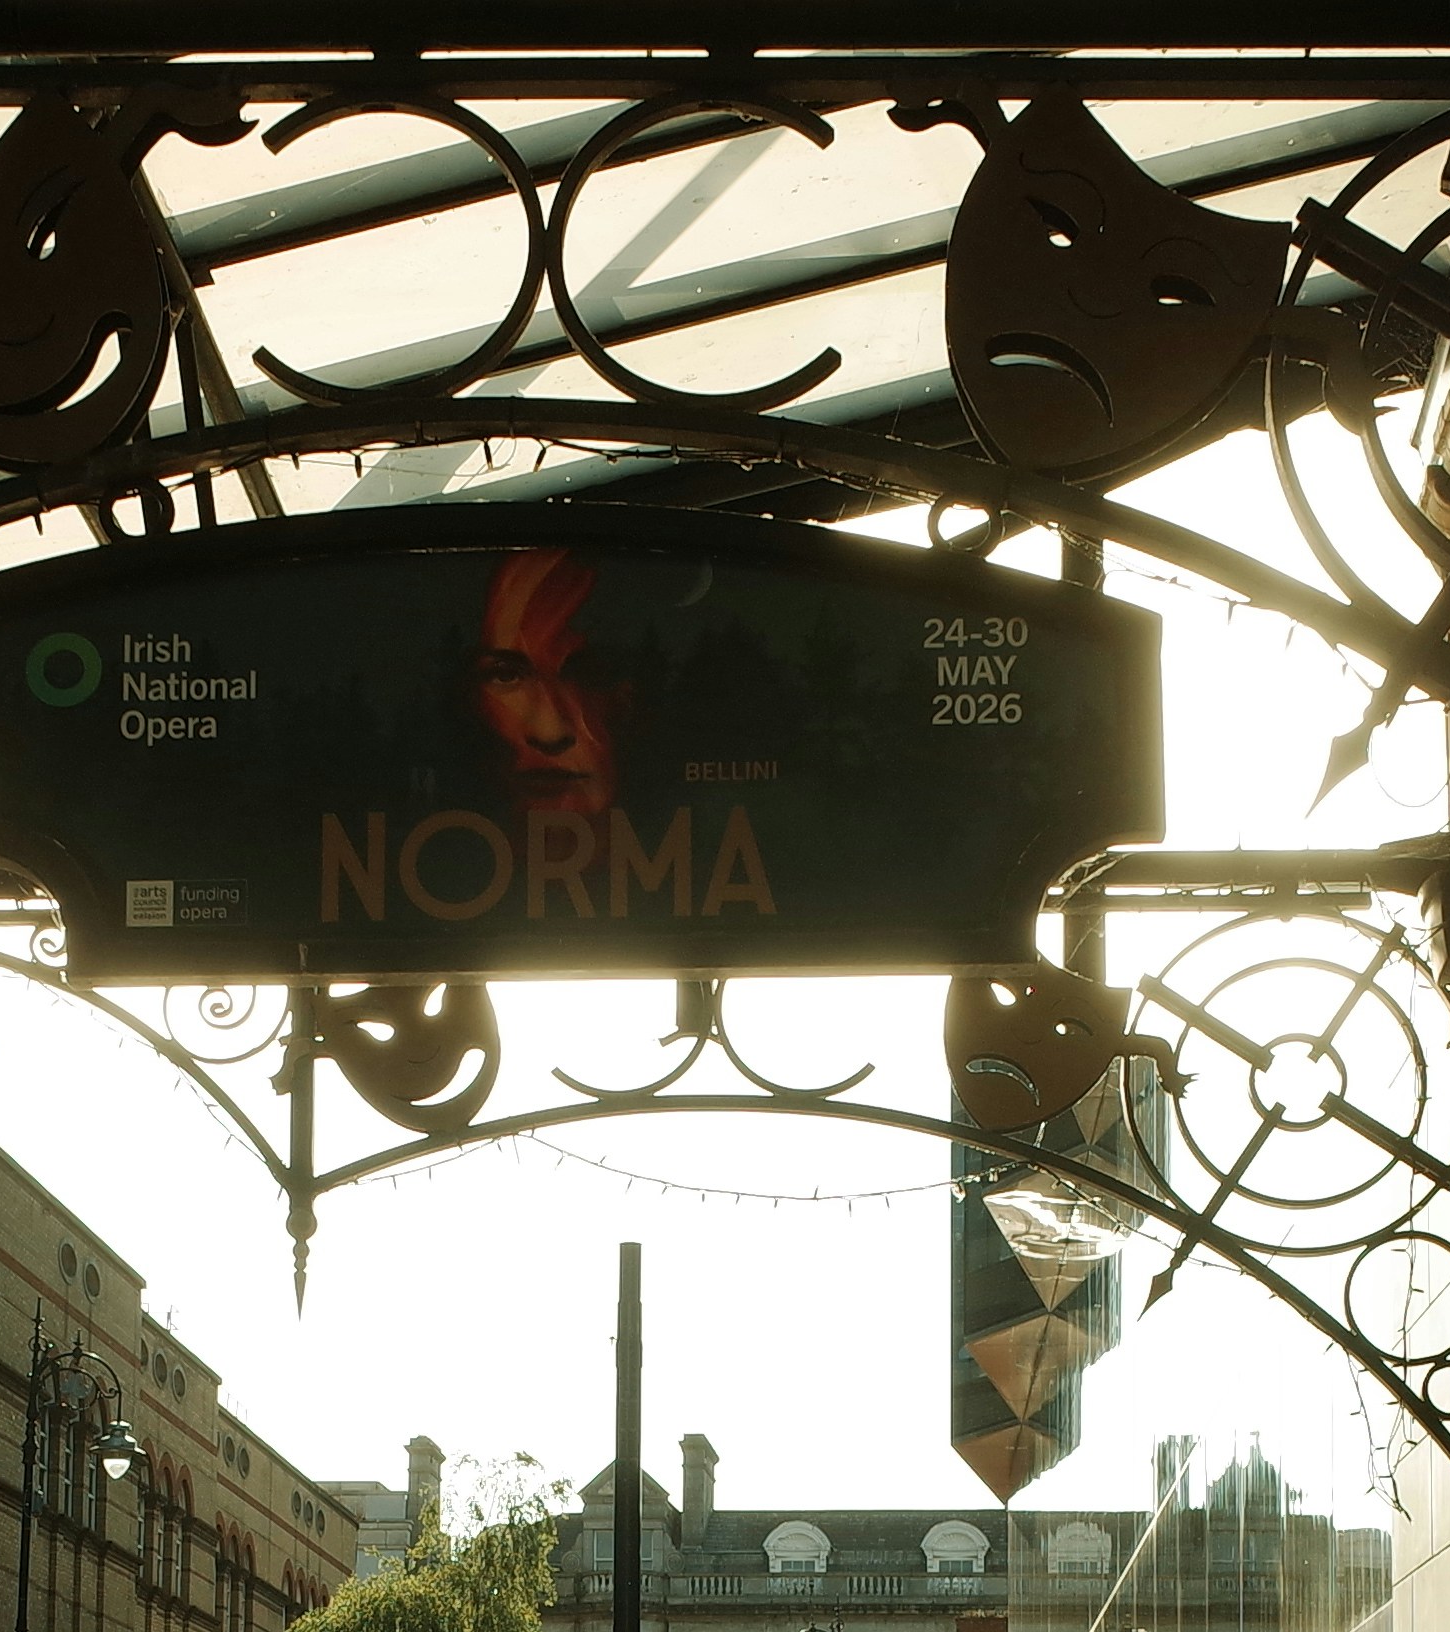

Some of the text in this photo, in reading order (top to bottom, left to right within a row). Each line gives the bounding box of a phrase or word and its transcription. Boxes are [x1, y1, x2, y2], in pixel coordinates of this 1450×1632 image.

[123, 633, 191, 663] Irish
[923, 617, 1028, 648] 24-30
[122, 670, 257, 701] National
[937, 655, 1017, 686] MAY
[932, 693, 1022, 725] 2026
[119, 709, 218, 747] Opera
[684, 761, 778, 782] BELLINI
[320, 805, 777, 923] NORMA
[180, 886, 240, 903] funding
[180, 907, 227, 921] opera
